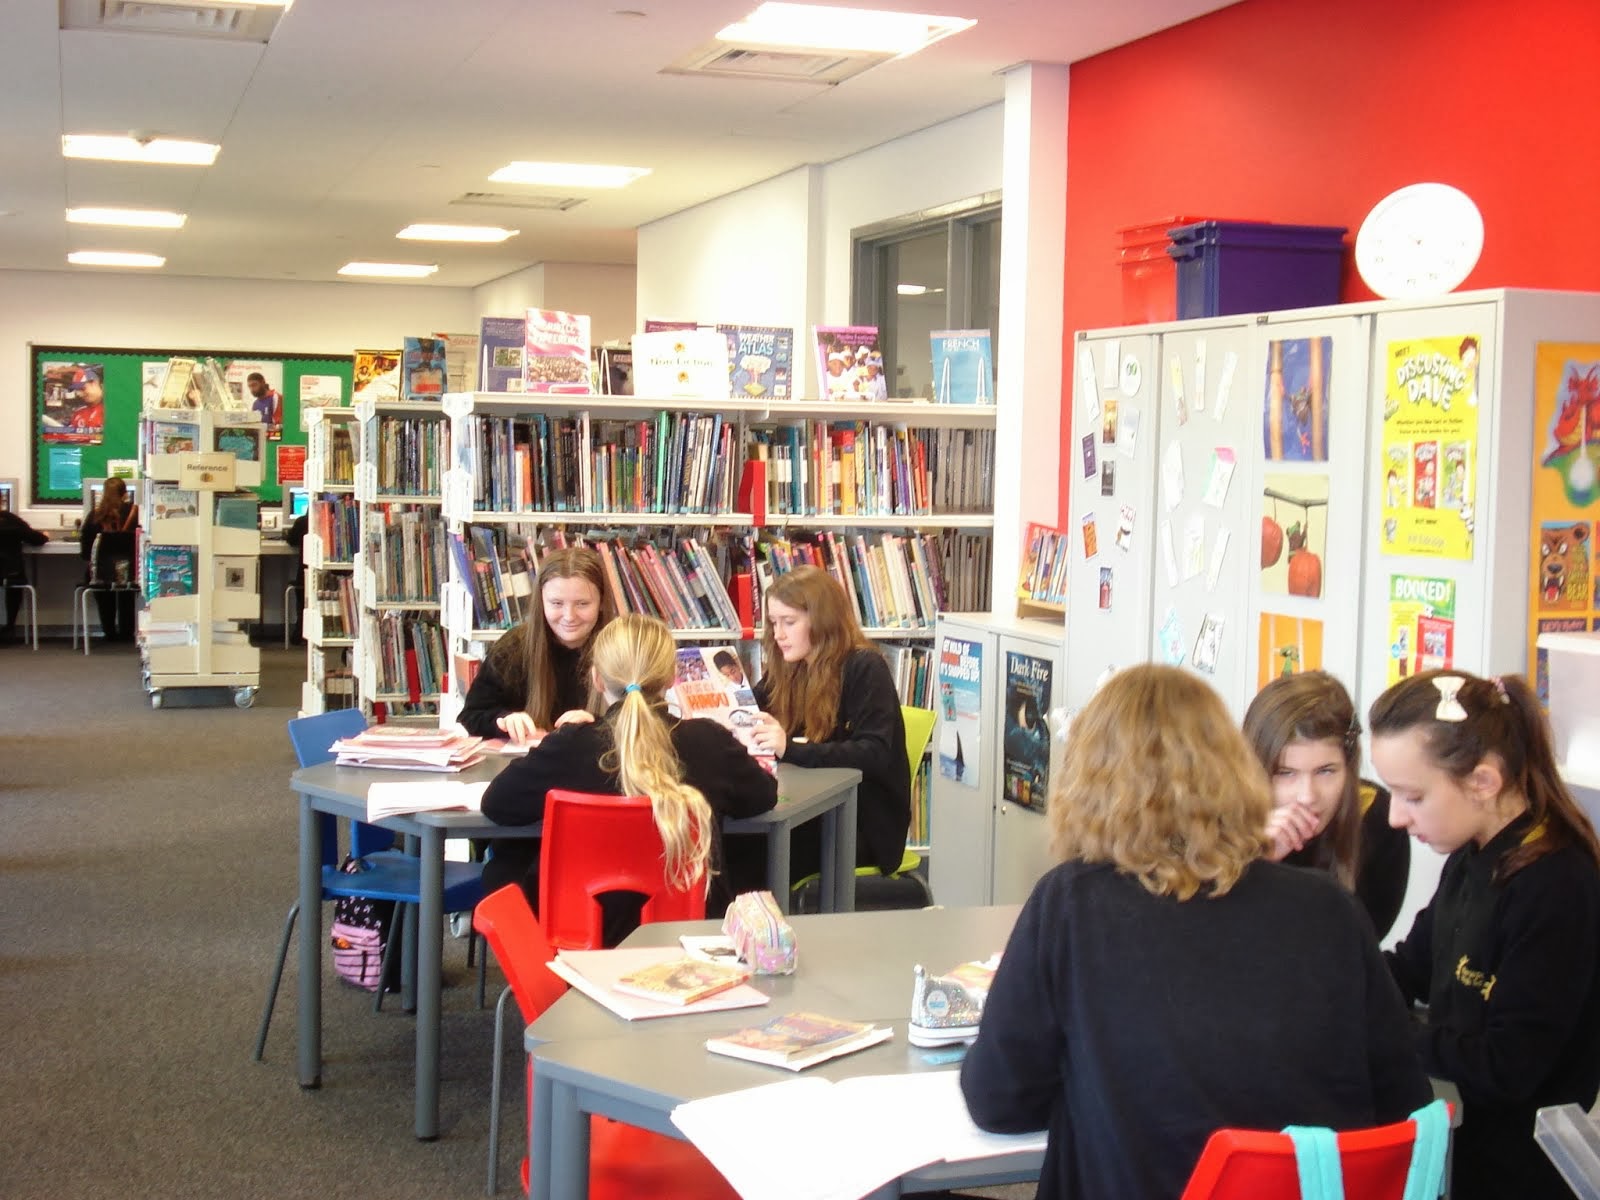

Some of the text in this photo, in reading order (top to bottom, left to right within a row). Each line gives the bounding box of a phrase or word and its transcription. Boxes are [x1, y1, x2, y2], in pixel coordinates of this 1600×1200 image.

[738, 332, 775, 344] WEATHER
[942, 338, 980, 348] FRENCH
[738, 343, 774, 356] ATLAS
[1396, 351, 1466, 391] DISGUSTING
[1407, 374, 1453, 412] DAVE
[186, 463, 228, 472] Reference
[1395, 577, 1451, 602] BOOKED!
[950, 640, 962, 655] HOLD
[1010, 655, 1049, 682] Dark Fire
